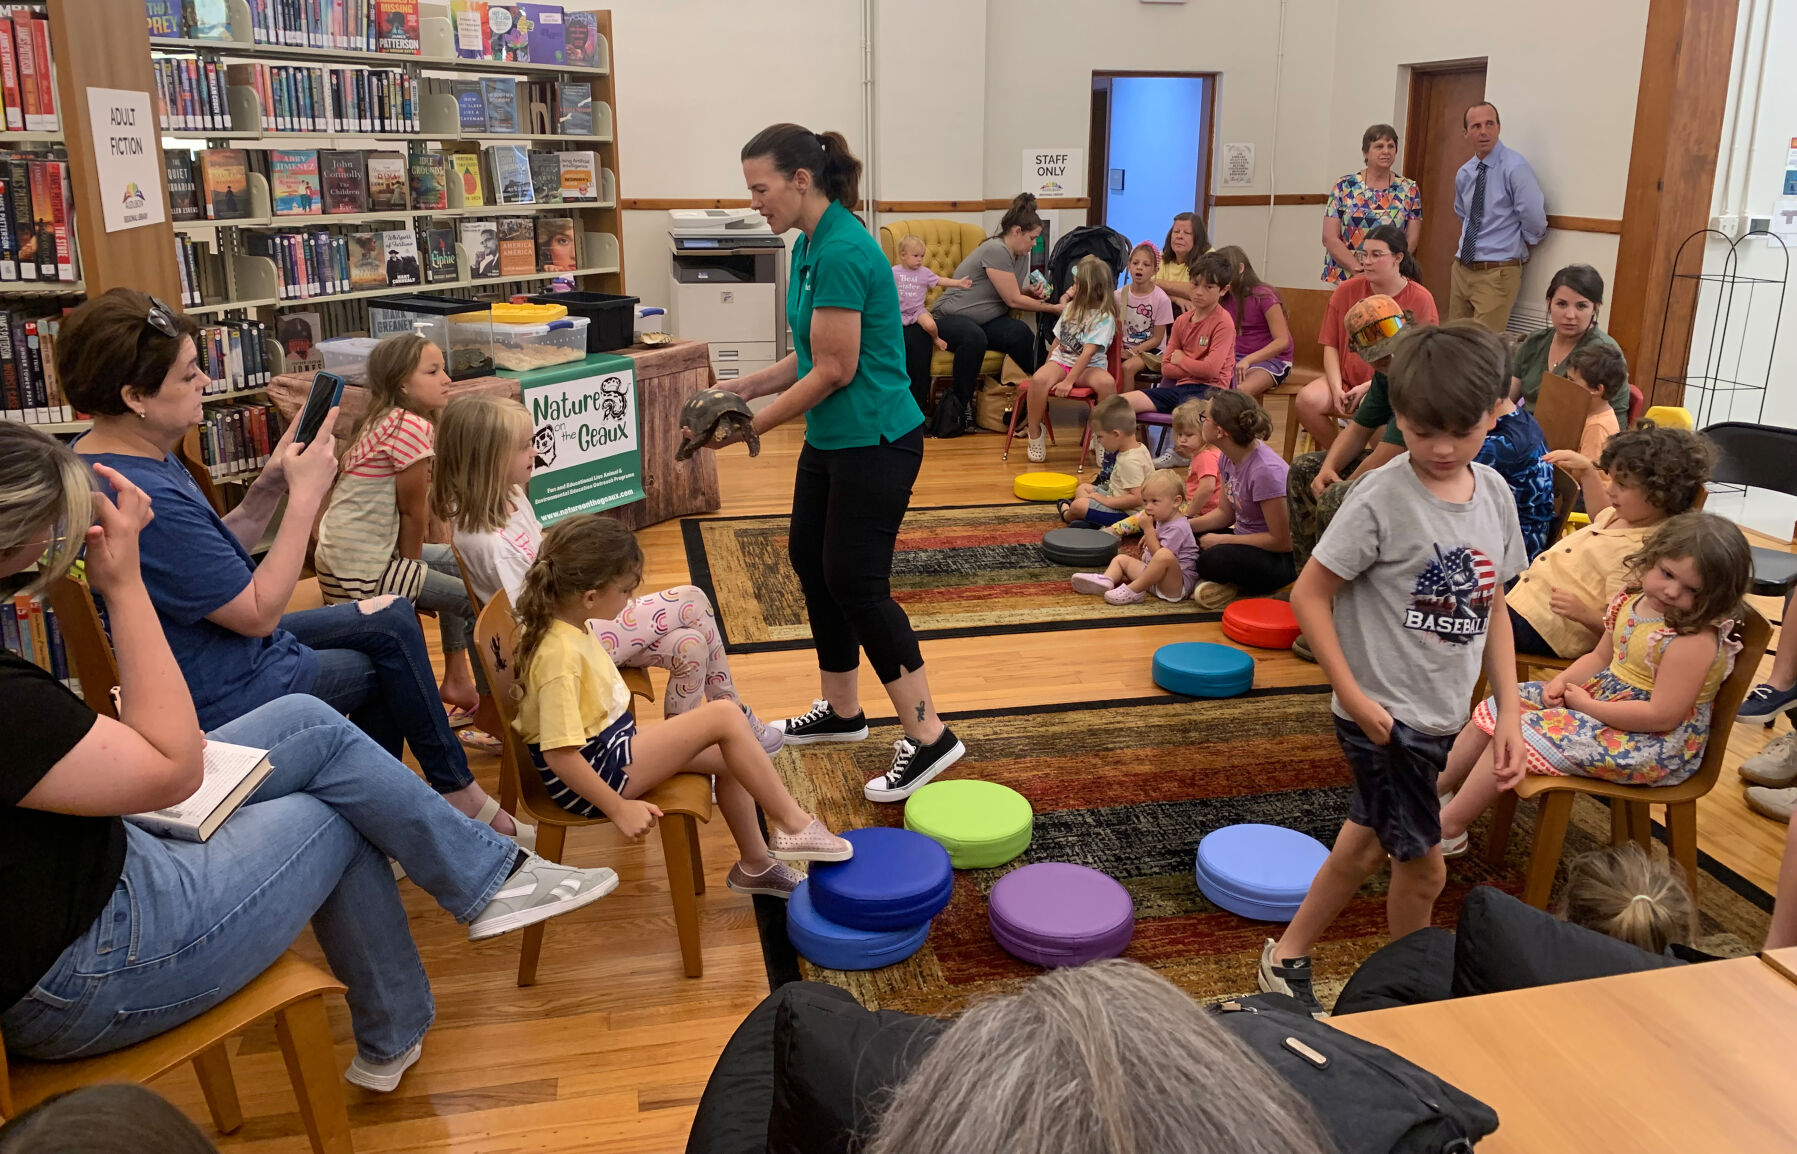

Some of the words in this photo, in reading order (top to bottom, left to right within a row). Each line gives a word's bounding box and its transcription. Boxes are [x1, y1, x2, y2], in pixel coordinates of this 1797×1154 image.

[380, 3, 414, 13] MISSING
[379, 38, 419, 49] PATTERSON
[2, 53, 14, 87] PATTERSON
[110, 107, 136, 126] ADULT
[110, 137, 143, 156] FICTION
[284, 155, 306, 163] ABBY
[333, 160, 353, 169] John
[419, 156, 434, 165] IDLE
[1035, 154, 1068, 165] STAFF
[277, 162, 315, 170] JIMENEZ
[411, 166, 442, 175] GROUNDS
[1037, 166, 1066, 177] ONLY
[167, 168, 188, 180] QUIET
[323, 170, 361, 180] Connolly
[168, 182, 195, 192] IBRARIAN
[431, 251, 456, 268] Elphie
[377, 319, 414, 333] GREANEY
[533, 391, 601, 427] Nature
[554, 422, 566, 433] on
[561, 430, 577, 443] the
[578, 421, 629, 452] Geaux
[566, 476, 594, 490] Educational
[593, 473, 603, 481] Live
[603, 469, 618, 478] Animal
[569, 484, 593, 495] Education
[593, 478, 614, 488] Outreach
[613, 472, 635, 482] Programs
[540, 489, 634, 521] www.natureonthegeaux.com
[1404, 609, 1488, 635] BASEBALL
